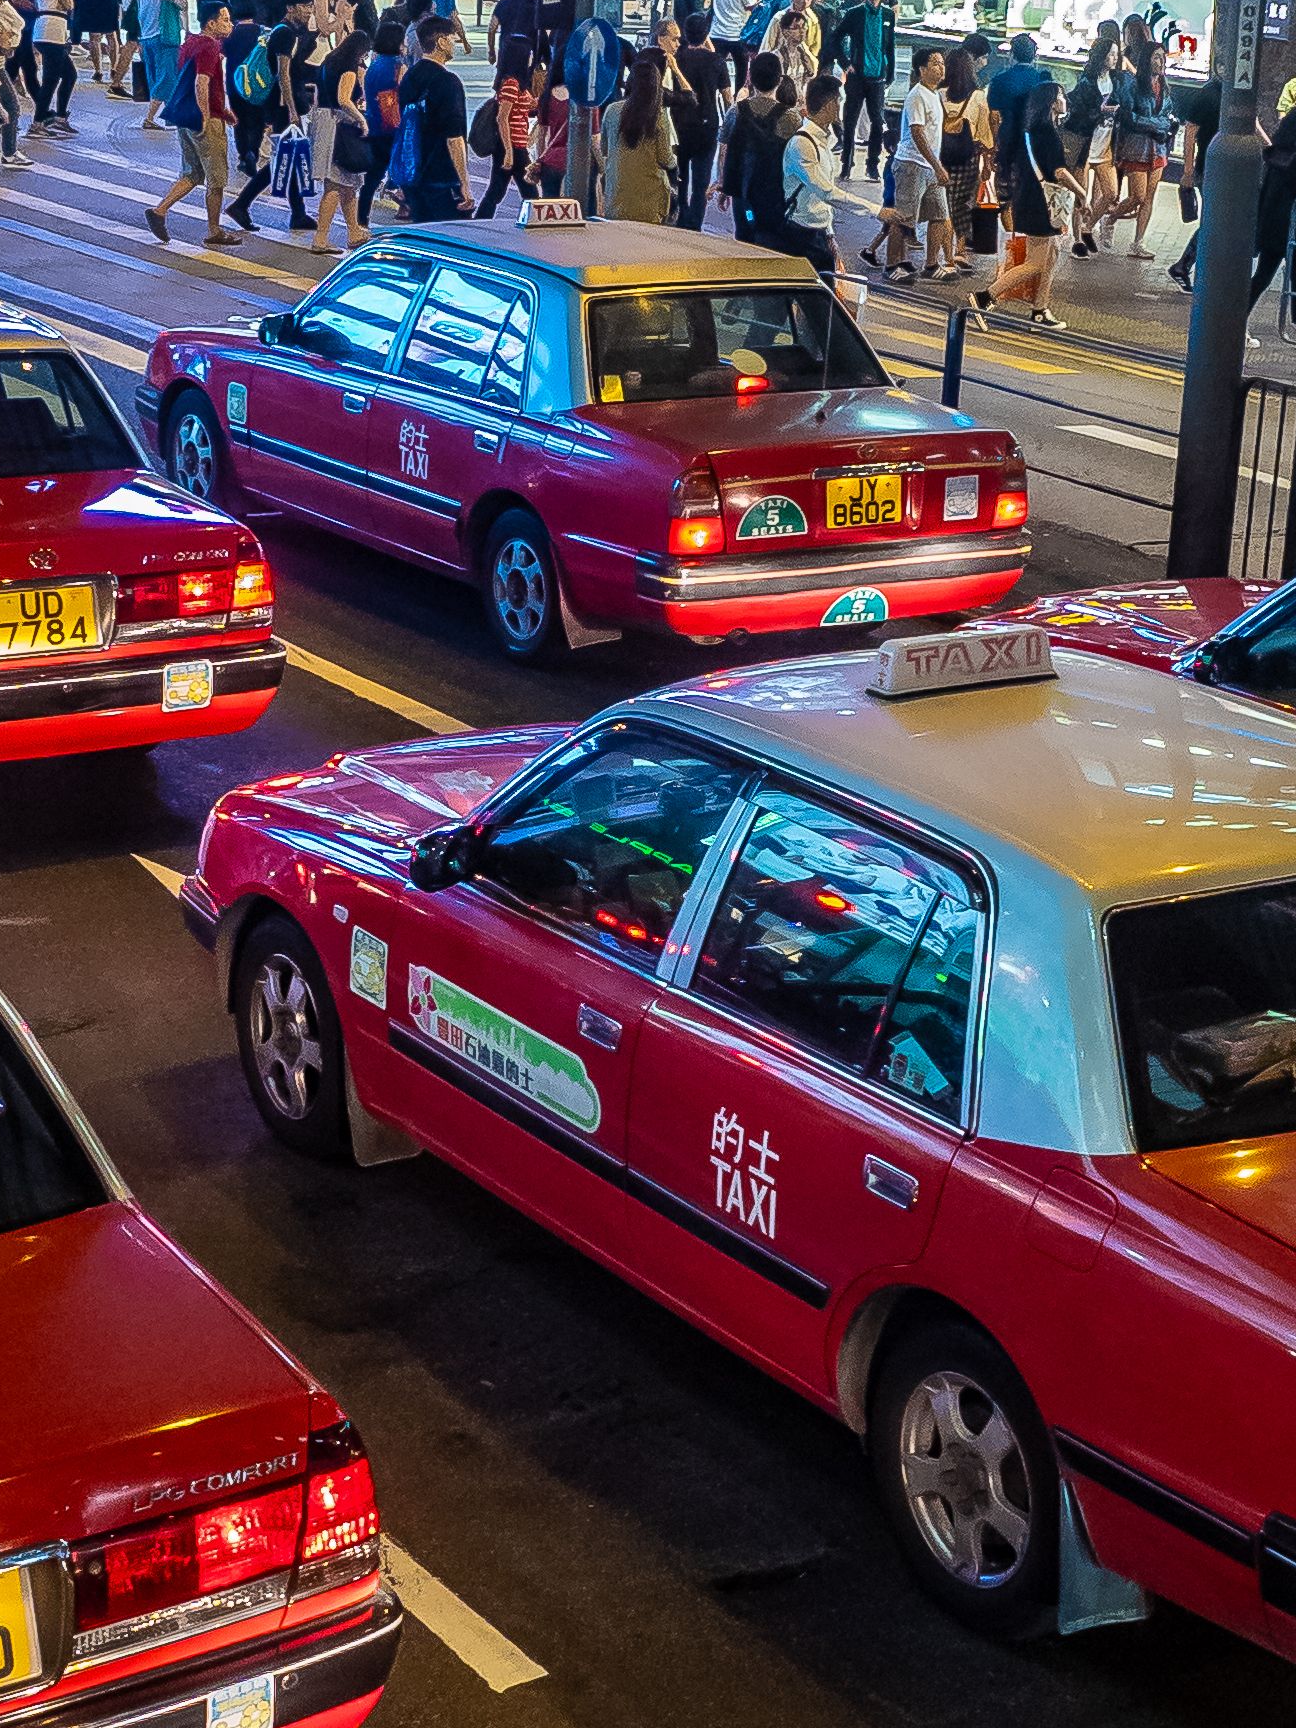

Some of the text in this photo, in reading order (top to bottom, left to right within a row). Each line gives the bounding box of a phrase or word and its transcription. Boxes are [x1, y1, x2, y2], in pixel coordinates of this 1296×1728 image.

[533, 203, 579, 222] TAXI
[399, 419, 430, 452] 的士
[398, 445, 429, 480] TAXI
[760, 499, 788, 511] TAXI
[852, 476, 882, 506] JY
[766, 510, 781, 525] 5
[833, 498, 898, 526] 8602
[752, 525, 793, 536] SEATS
[20, 589, 66, 622] UD
[848, 589, 878, 601] TAXI
[850, 599, 867, 614] 5
[835, 612, 875, 624] SEATS
[905, 633, 1040, 675] TAXI
[710, 1106, 781, 1186] 的士
[709, 1154, 776, 1240] TAXI
[190, 1452, 302, 1495] COMFORT
